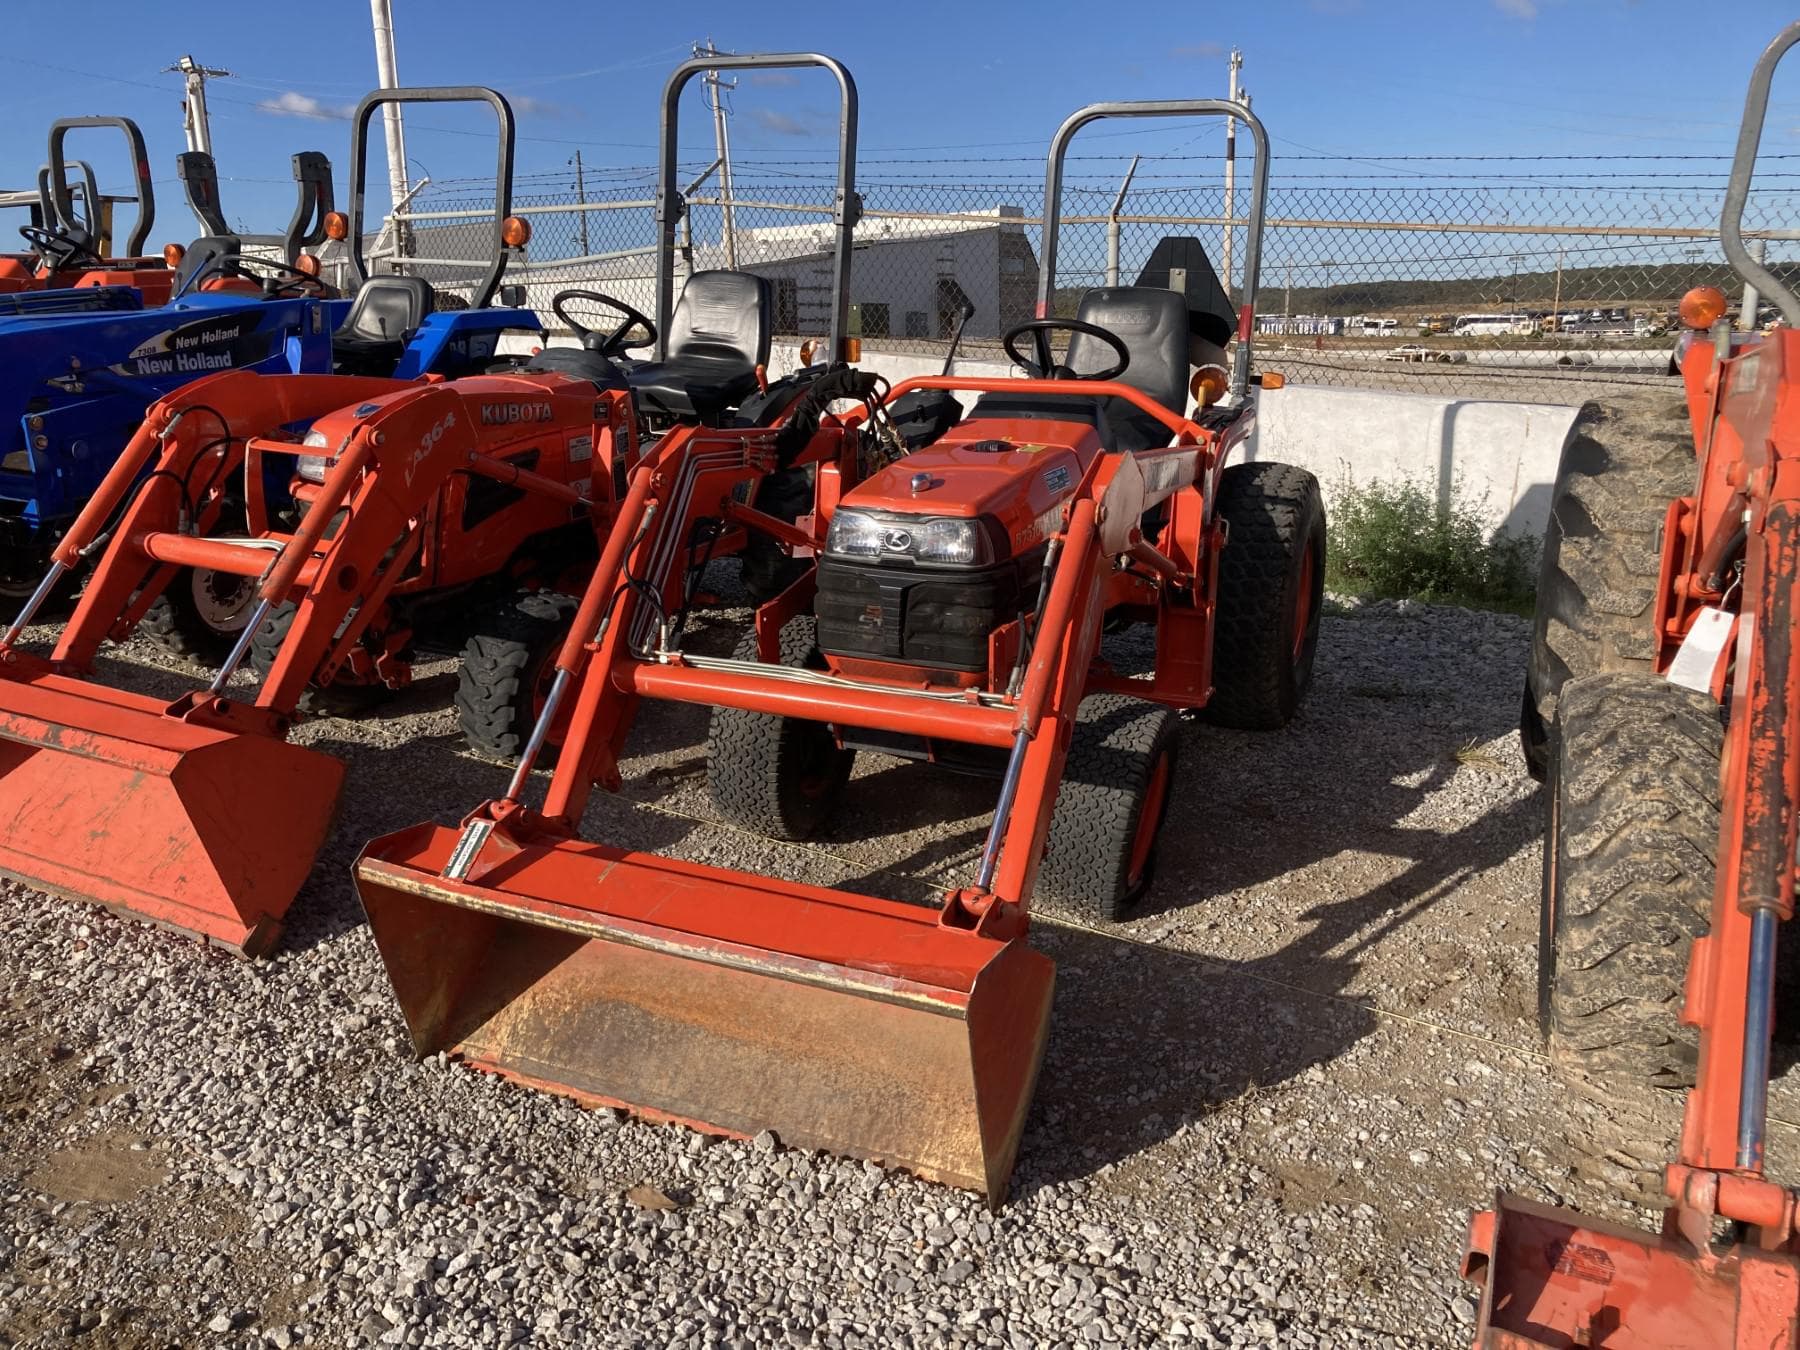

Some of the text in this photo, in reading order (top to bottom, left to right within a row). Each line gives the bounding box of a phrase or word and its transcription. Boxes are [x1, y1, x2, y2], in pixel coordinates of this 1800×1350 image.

[176, 326, 239, 349] New Holland
[137, 350, 232, 375] New Holland
[481, 403, 553, 424] KUBOTA
[404, 411, 456, 488] LA364
